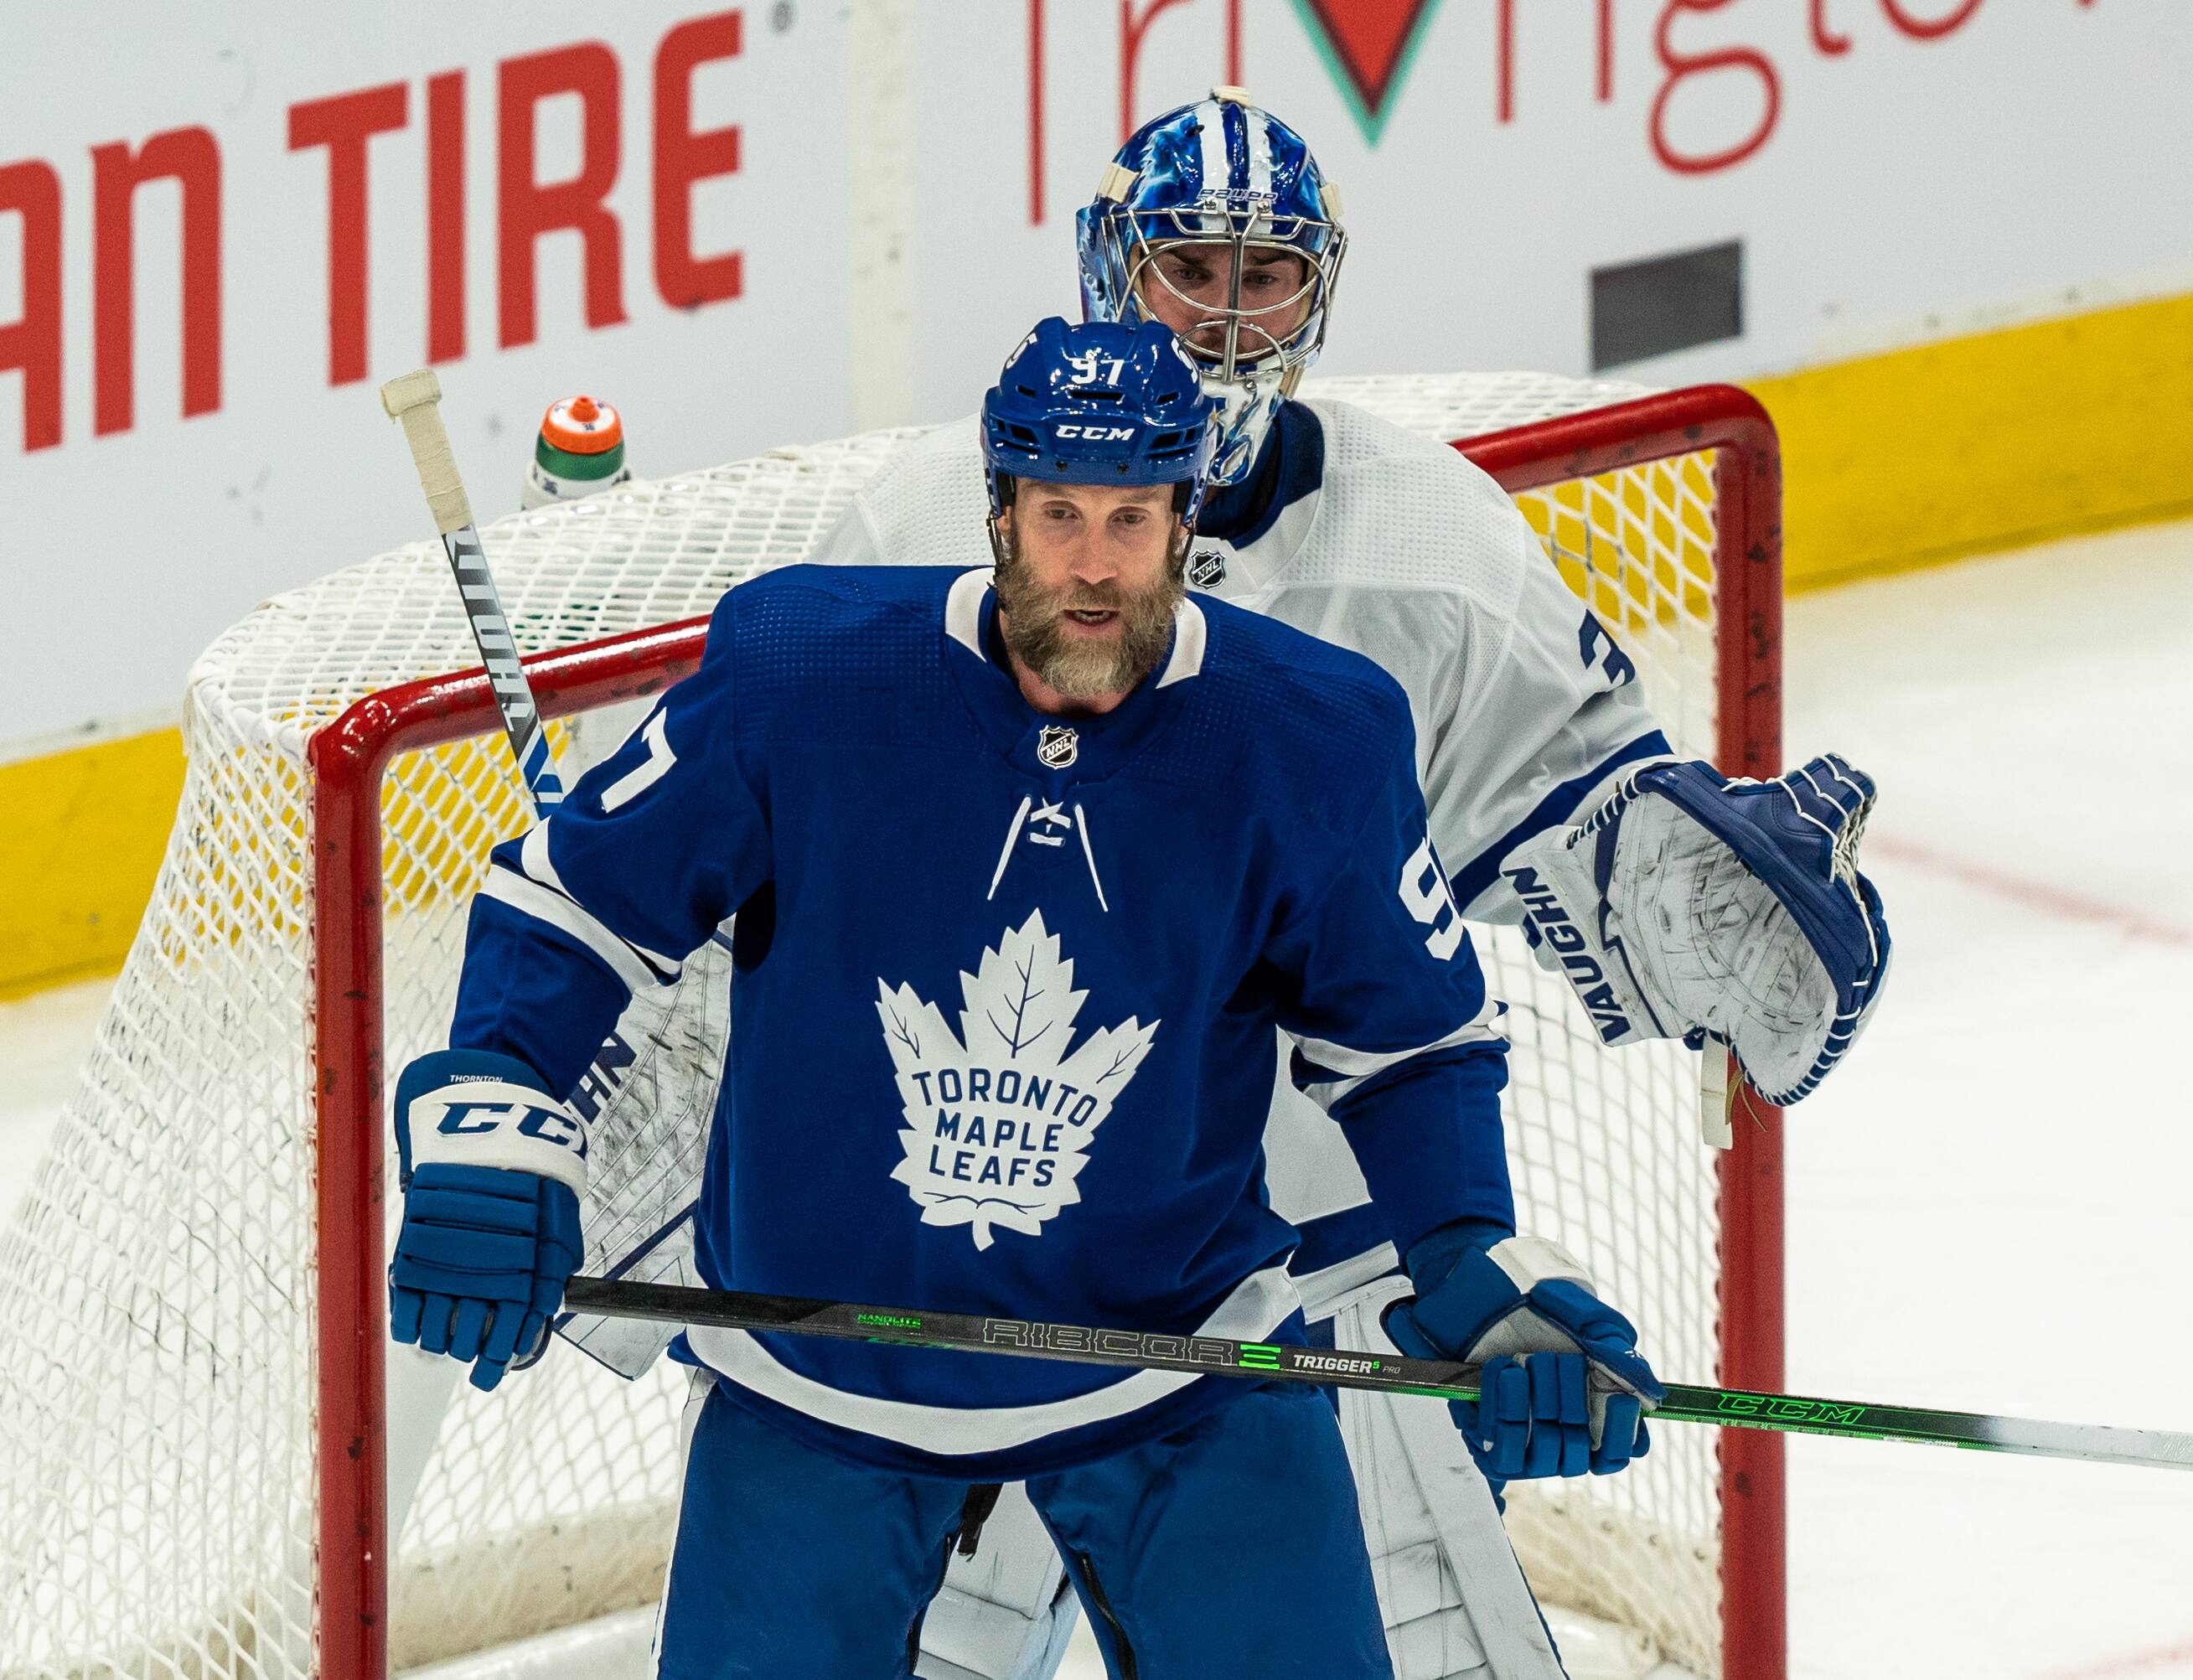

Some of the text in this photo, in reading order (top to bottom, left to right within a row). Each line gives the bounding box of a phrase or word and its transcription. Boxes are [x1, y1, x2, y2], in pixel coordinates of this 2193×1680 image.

[287, 7, 743, 388] TIRE
[1071, 357, 1125, 385] 97
[1055, 424, 1135, 442] CCM
[1197, 560, 1219, 581] NHL
[1046, 737, 1070, 758] NHL
[1502, 866, 1632, 1043] VAUGHN
[449, 1074, 504, 1083] THORNTON
[911, 1067, 1099, 1128] TORONTO
[436, 1102, 587, 1162] CC
[934, 1108, 1063, 1152] MAPLE
[928, 1144, 1056, 1187] LEAFS
[1383, 1365, 1401, 1375] PRO
[1717, 1393, 1866, 1424] CCM
